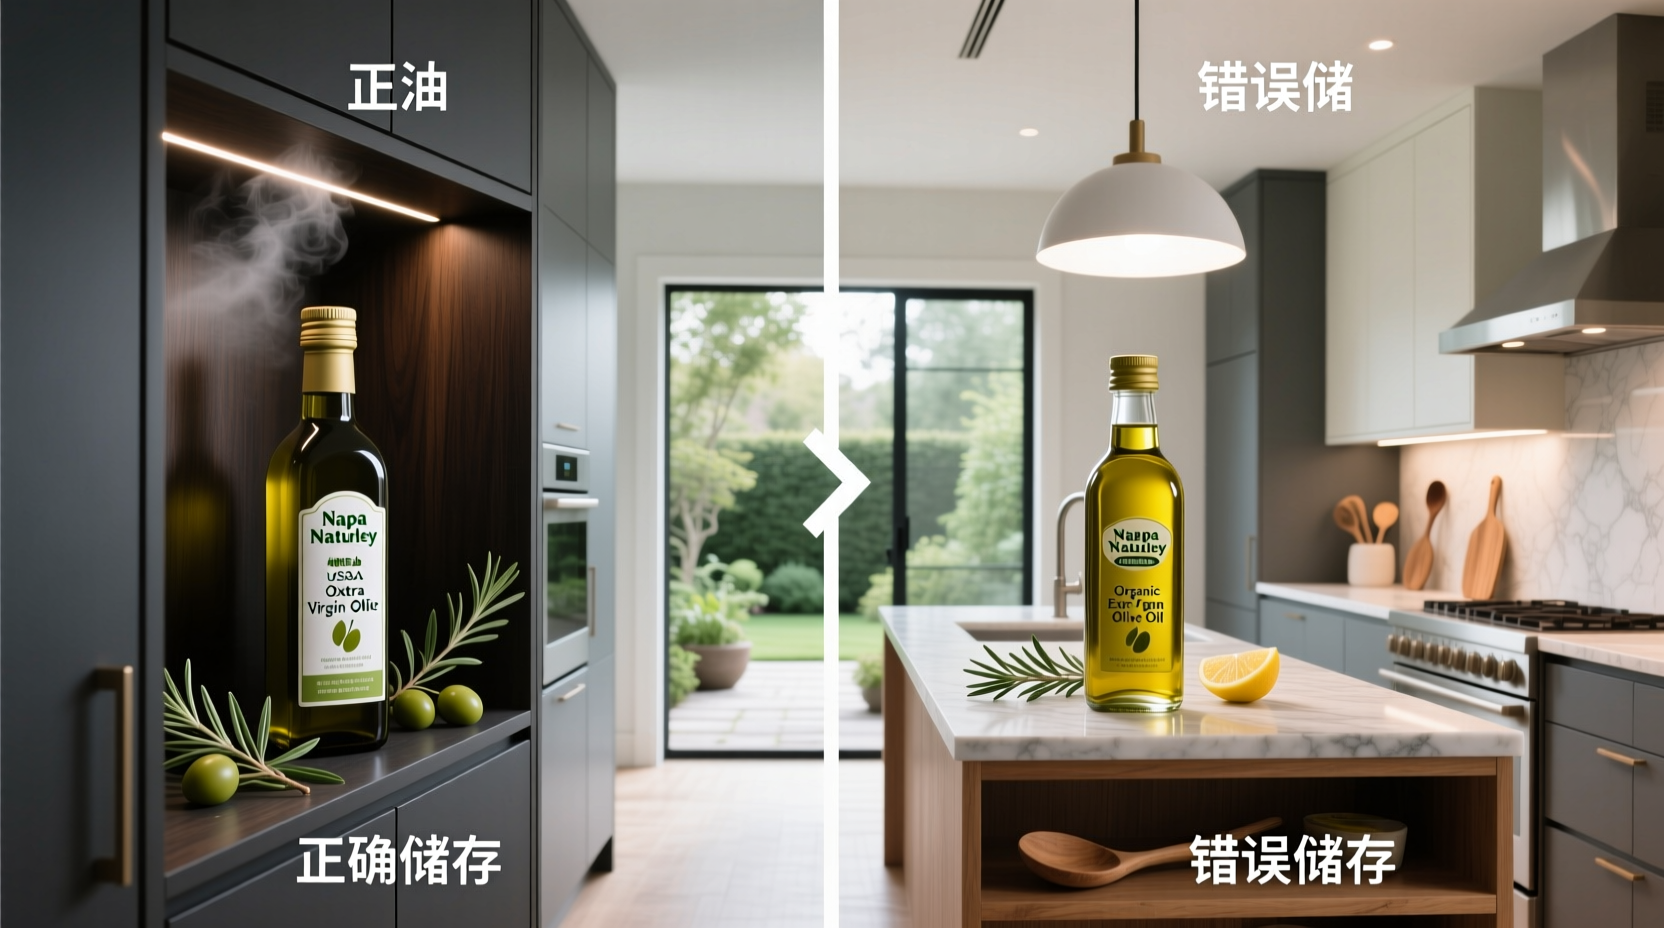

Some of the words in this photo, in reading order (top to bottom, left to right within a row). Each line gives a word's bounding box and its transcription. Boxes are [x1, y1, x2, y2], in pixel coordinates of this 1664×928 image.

[322, 510, 367, 530] Napa
[325, 584, 365, 598] Oxtra
[1114, 585, 1161, 600] Organic
[307, 600, 346, 618] Virgin
[1146, 611, 1164, 623] Oil
